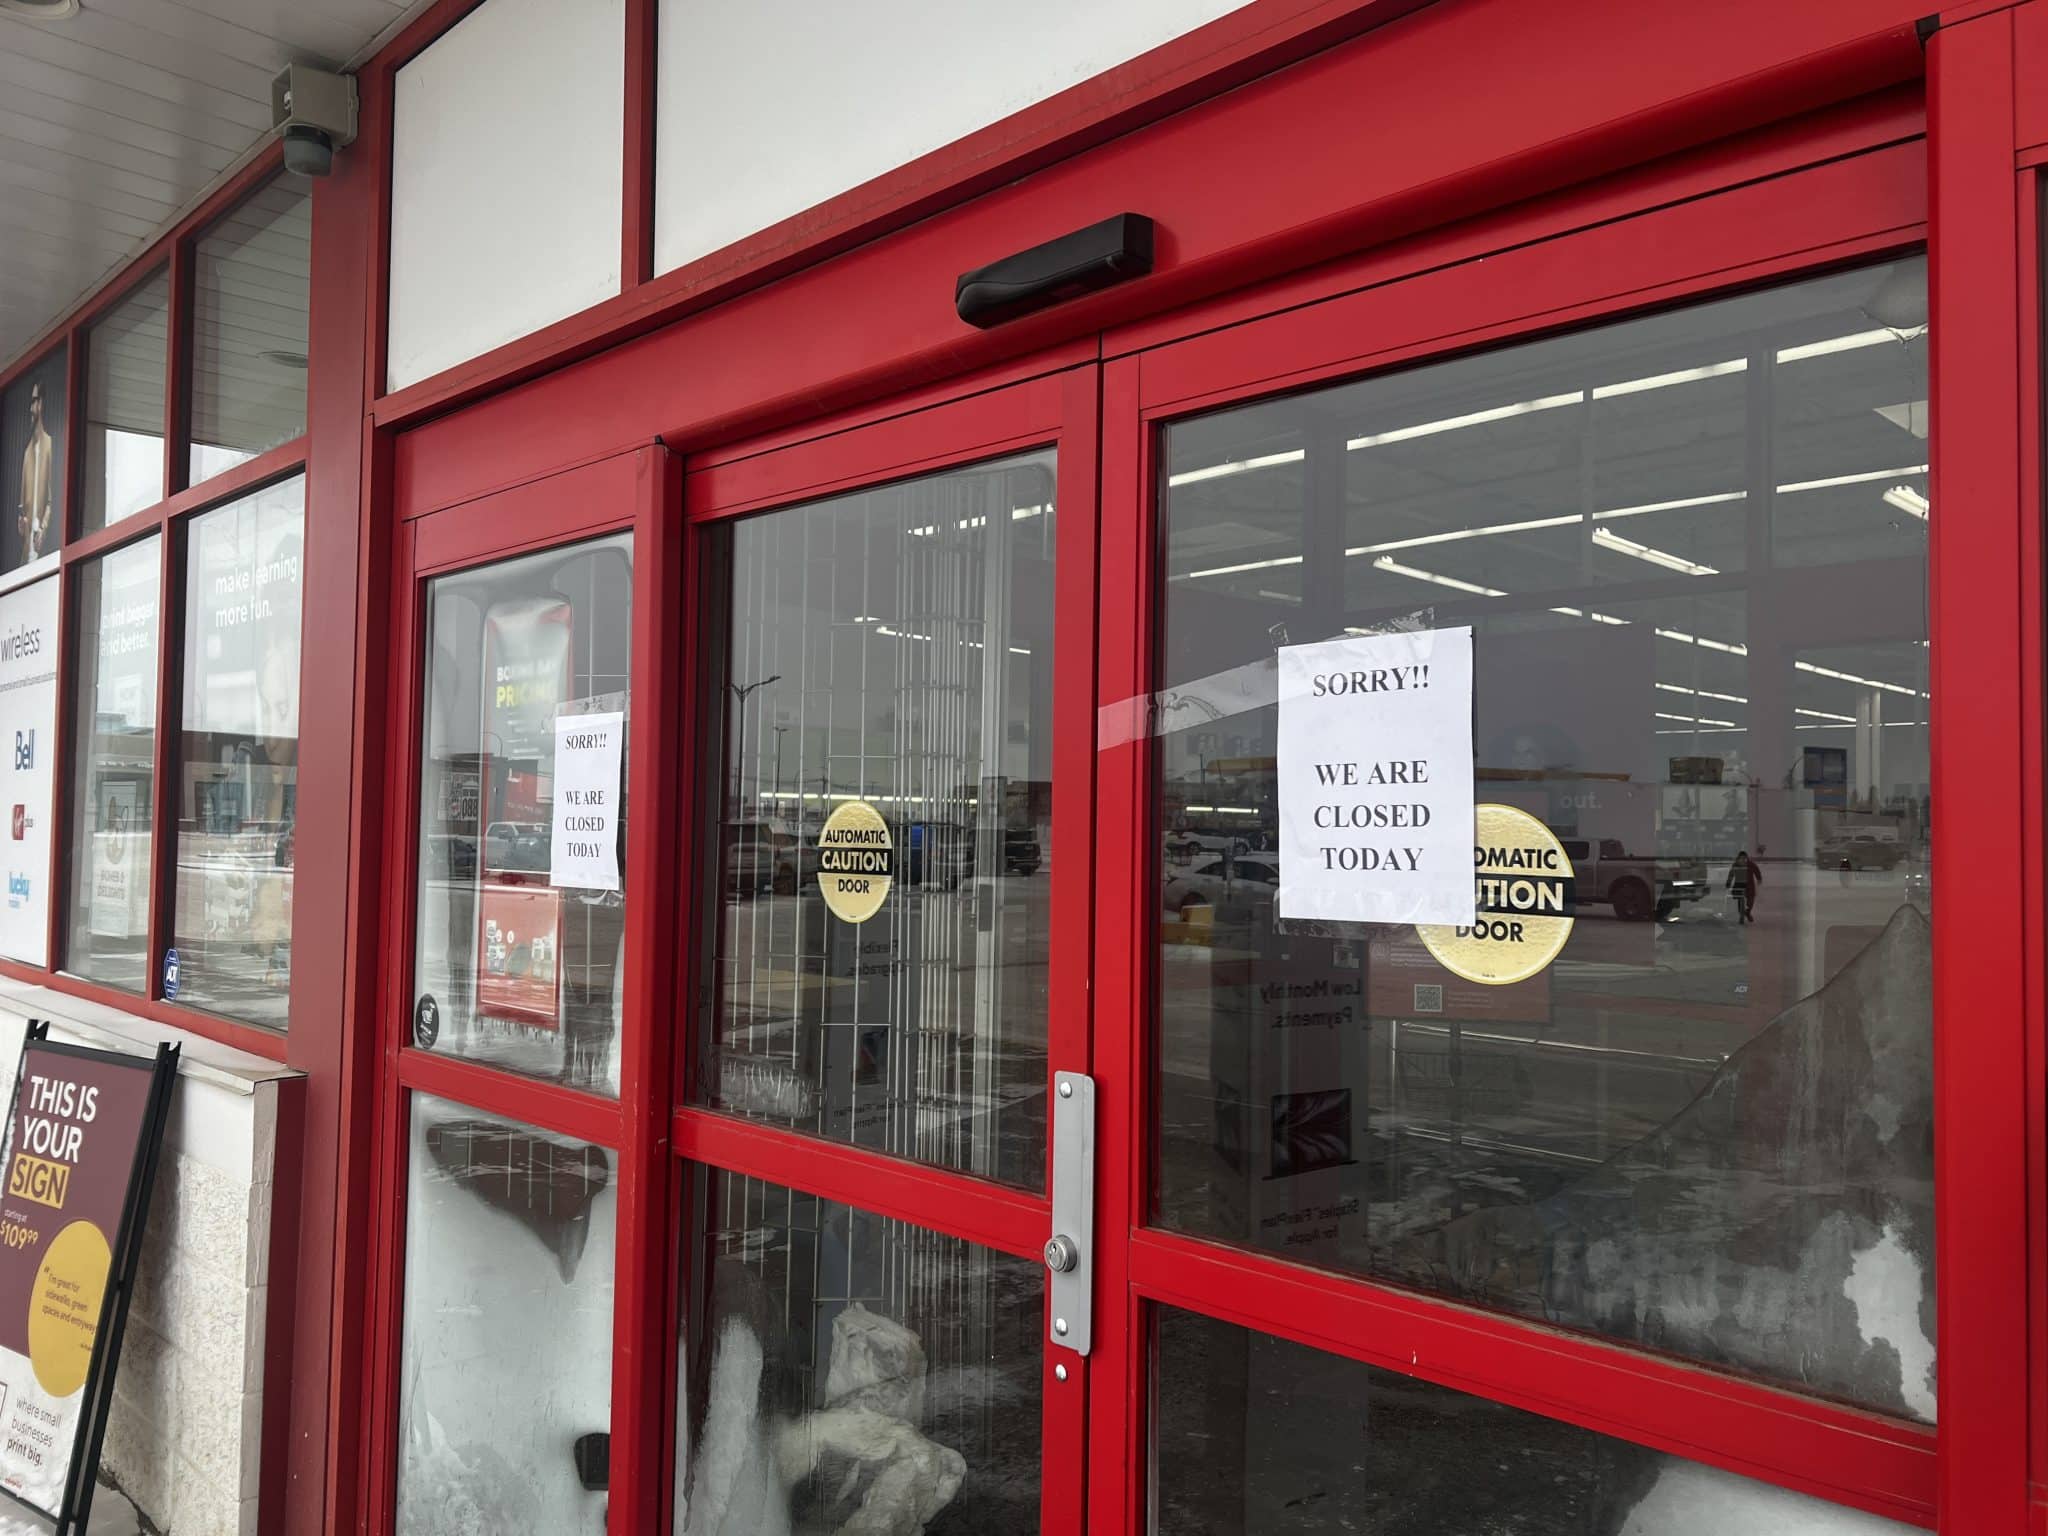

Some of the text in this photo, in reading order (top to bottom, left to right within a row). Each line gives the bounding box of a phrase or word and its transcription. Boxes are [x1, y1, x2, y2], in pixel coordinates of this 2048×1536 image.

[216, 553, 297, 595] make learning
[216, 597, 272, 628] more fun.
[1, 624, 40, 662] wireless
[1313, 665, 1429, 697] SORRY!!
[15, 729, 35, 770] Bell
[565, 733, 607, 750] SORRY!!
[1315, 760, 1429, 787] WE ARE
[566, 790, 604, 805] WE ARE
[565, 816, 605, 832] CLOSED
[1314, 804, 1431, 828] CLOSED
[568, 842, 601, 858] TODAY
[825, 829, 886, 844] AUTOMATIC
[822, 851, 888, 871] CAUTION
[1320, 847, 1424, 872] TODAY
[1474, 847, 1557, 869] OMATIC
[838, 879, 869, 894] DOOR
[1475, 879, 1564, 911] TION
[1456, 920, 1524, 942] DOOR
[30, 1076, 99, 1122] THIS IS
[22, 1115, 83, 1163] YOUR
[12, 1157, 66, 1204] SIGN
[17, 1397, 62, 1429] where small
[11, 1416, 53, 1448] businesses
[6, 1437, 43, 1467] print big.
